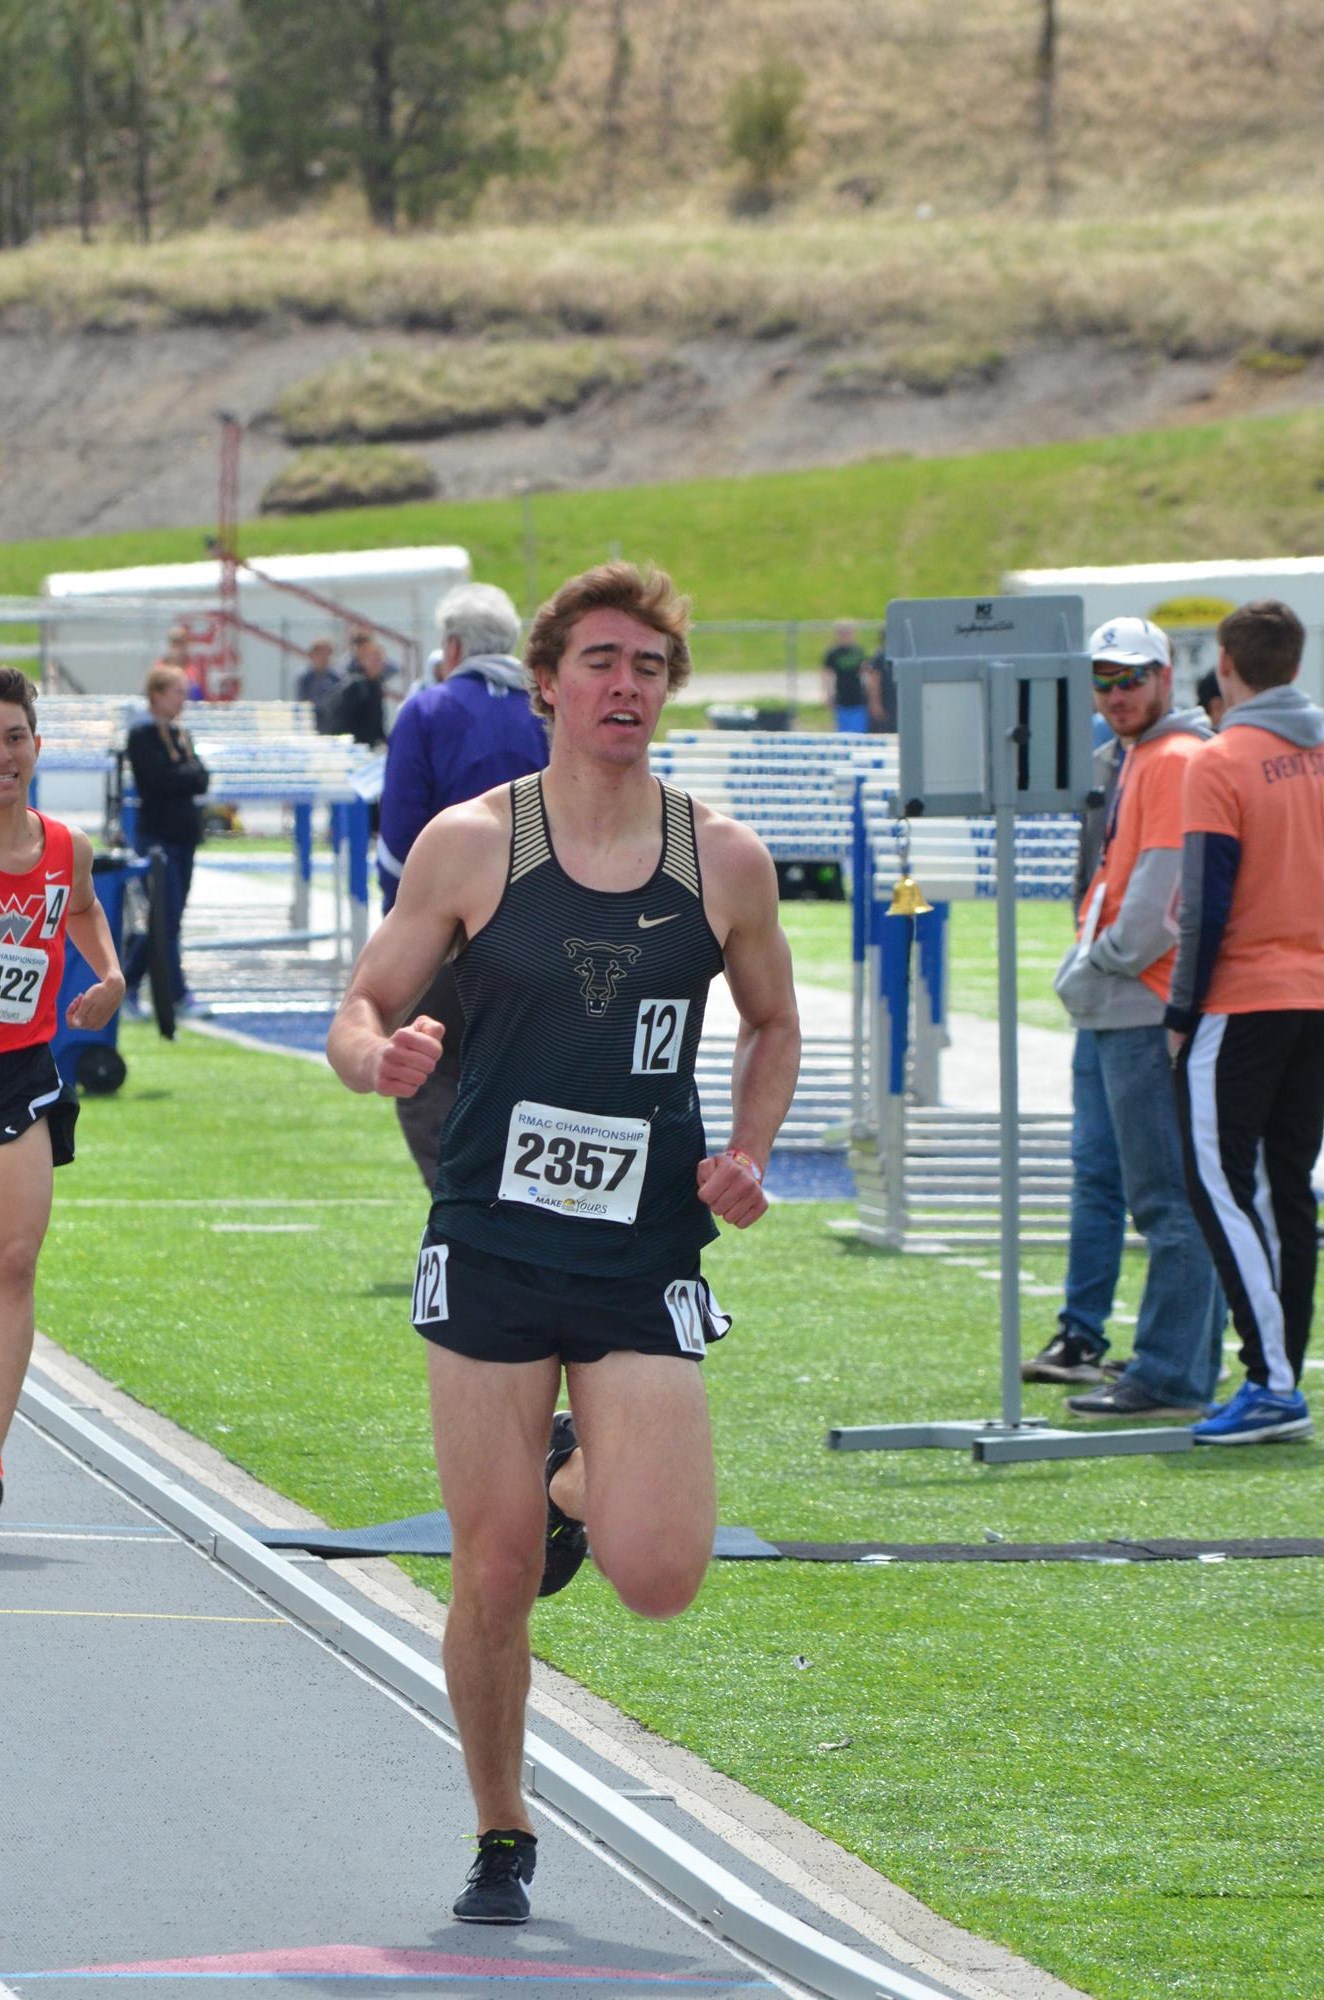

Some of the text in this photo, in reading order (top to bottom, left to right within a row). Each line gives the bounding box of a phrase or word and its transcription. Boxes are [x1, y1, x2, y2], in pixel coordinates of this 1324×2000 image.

[1262, 752, 1307, 784] EVENT
[46, 888, 65, 935] 4
[641, 1004, 677, 1070] 12
[518, 1113, 644, 1142] RMAC CHAMPIONSHIP
[513, 1132, 638, 1192] 2357
[535, 1196, 563, 1208] MAKE
[421, 1251, 441, 1320] 12
[667, 1285, 702, 1350] 12
